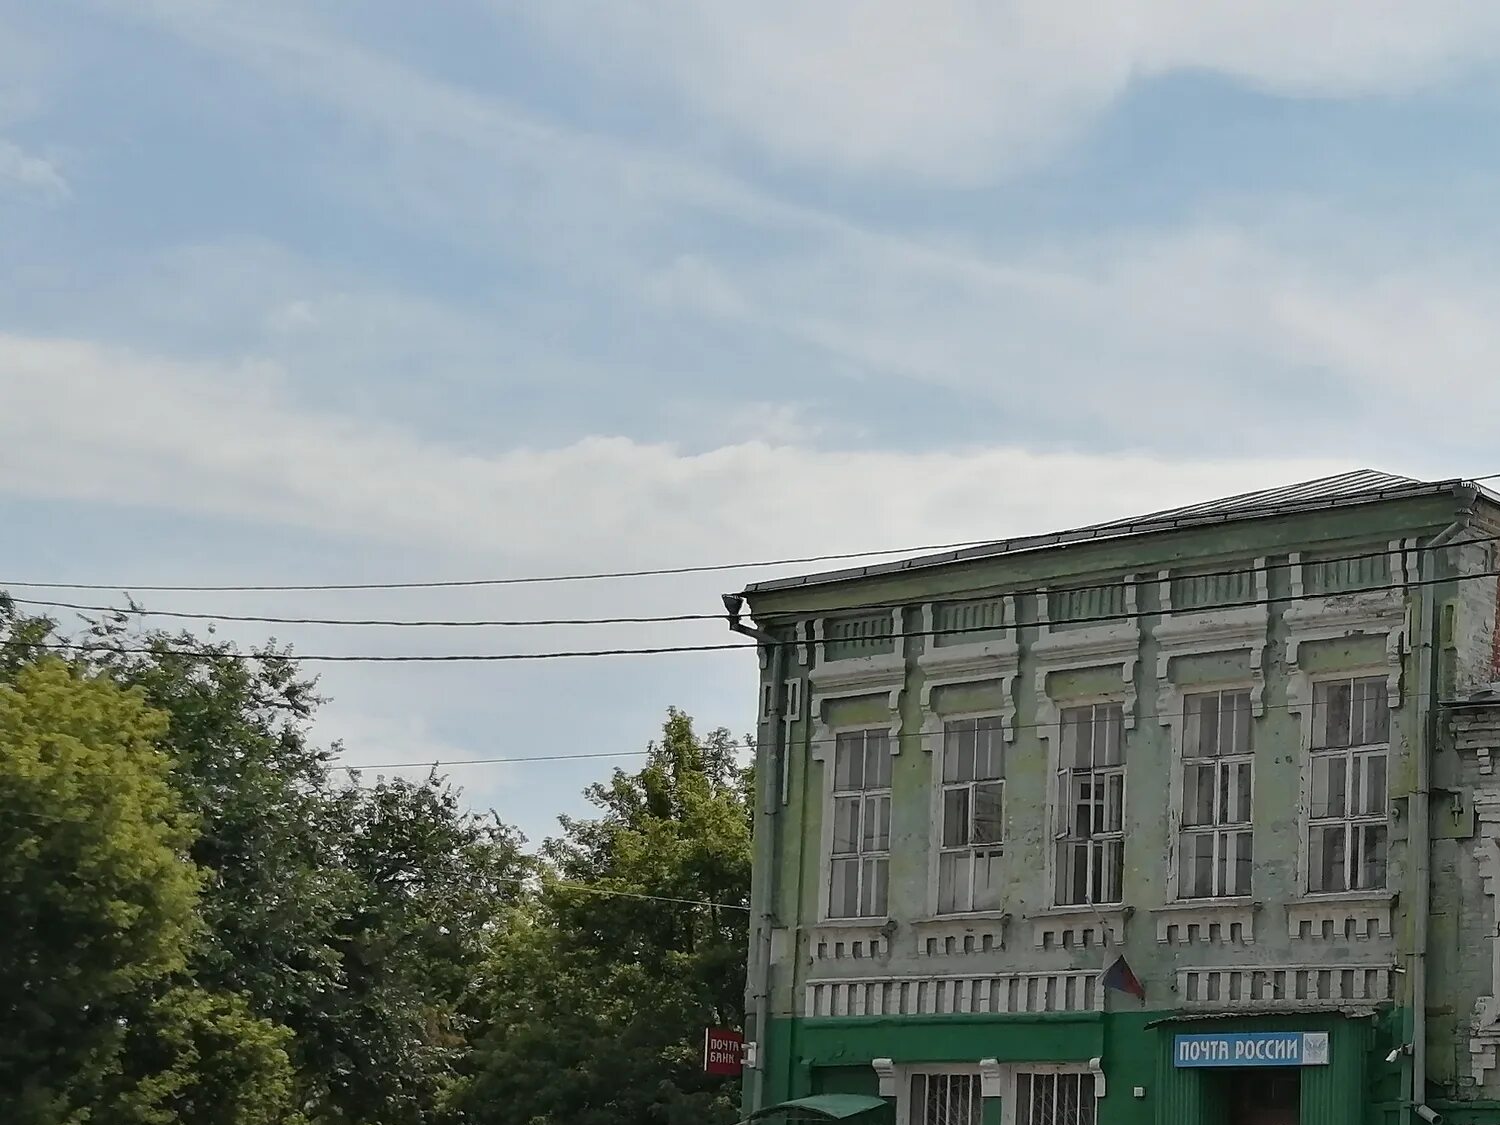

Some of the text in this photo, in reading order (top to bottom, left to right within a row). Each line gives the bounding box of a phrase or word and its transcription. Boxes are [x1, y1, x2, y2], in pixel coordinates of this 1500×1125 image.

[711, 1039, 739, 1051] ПОЧТА
[1179, 1038, 1298, 1061] ПОЧТА РОССИИ
[710, 1051, 735, 1064] БАНК
